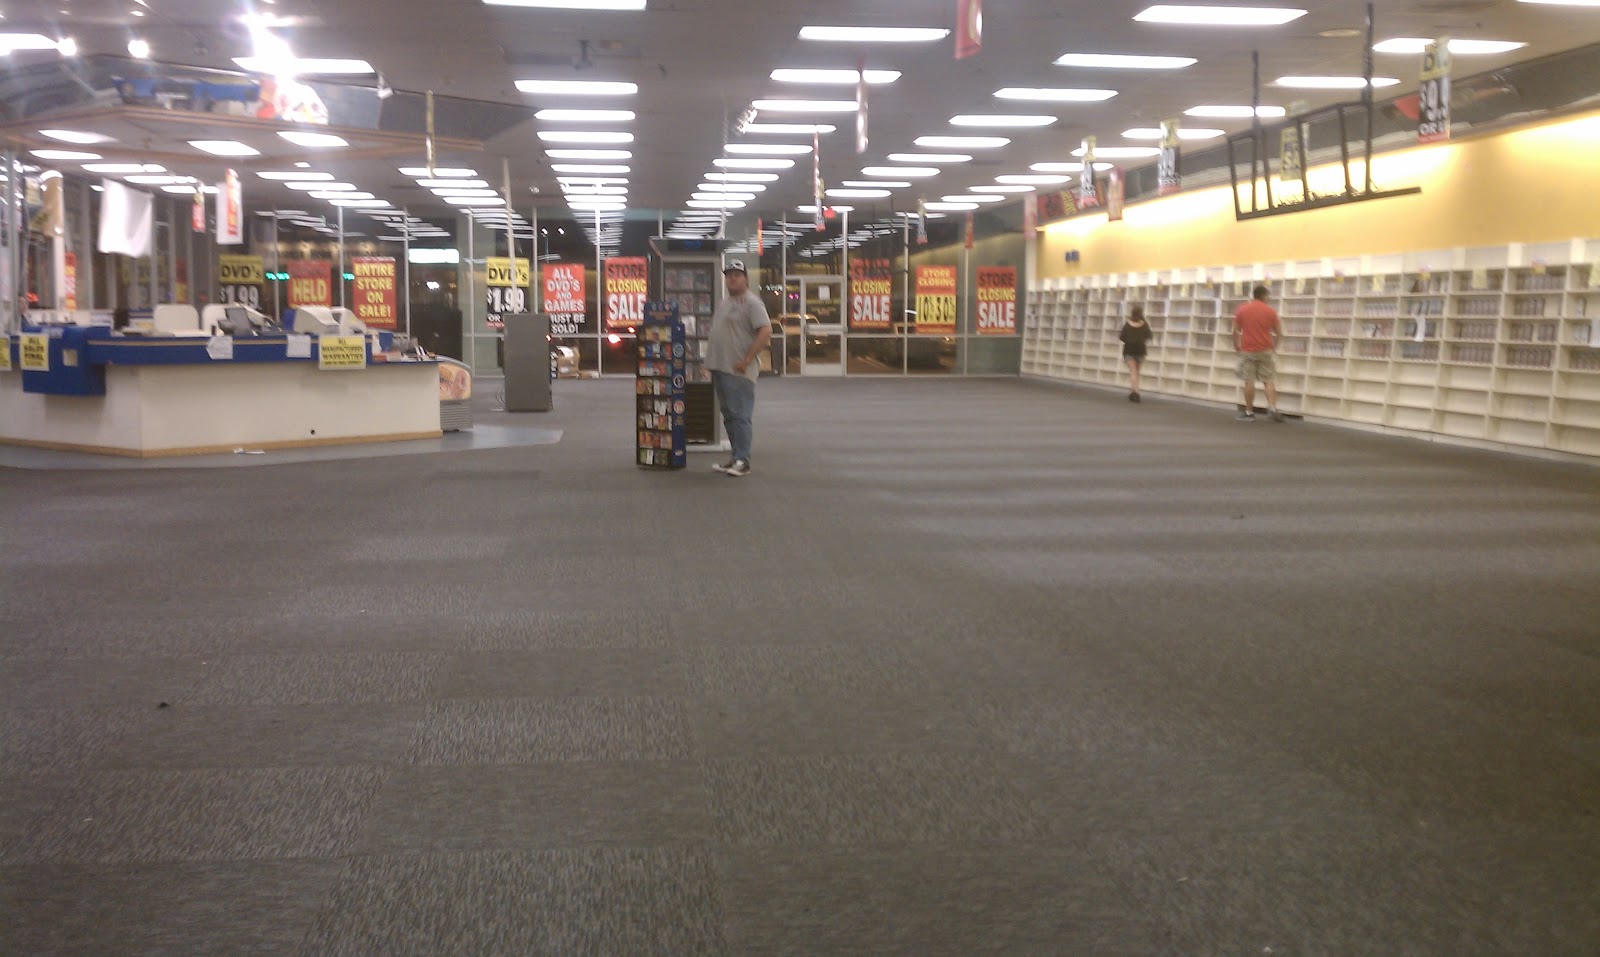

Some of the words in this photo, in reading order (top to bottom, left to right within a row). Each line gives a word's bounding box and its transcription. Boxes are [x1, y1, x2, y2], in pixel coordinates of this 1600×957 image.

[221, 265, 262, 280] DVD's
[354, 263, 395, 276] ENTIRE
[553, 268, 574, 279] ALL
[608, 264, 646, 278] STORE
[923, 268, 951, 278] STORE
[357, 278, 393, 290] STORE
[919, 278, 956, 287] CLOSING
[979, 272, 1015, 286] STORE
[292, 278, 328, 303] HELD
[547, 280, 581, 292] DVD'S
[607, 279, 648, 293] CLOSING
[852, 280, 892, 294] CLOSING
[366, 291, 384, 303] ON
[556, 292, 572, 300] AND
[978, 287, 1016, 301] CLOSING
[359, 304, 391, 317] SALE!
[544, 299, 585, 312] GAMES
[608, 293, 647, 320] SALE
[853, 294, 891, 321] SALE
[573, 312, 585, 323] BE
[978, 301, 1015, 328] SALE
[551, 323, 579, 334] SOLD!
